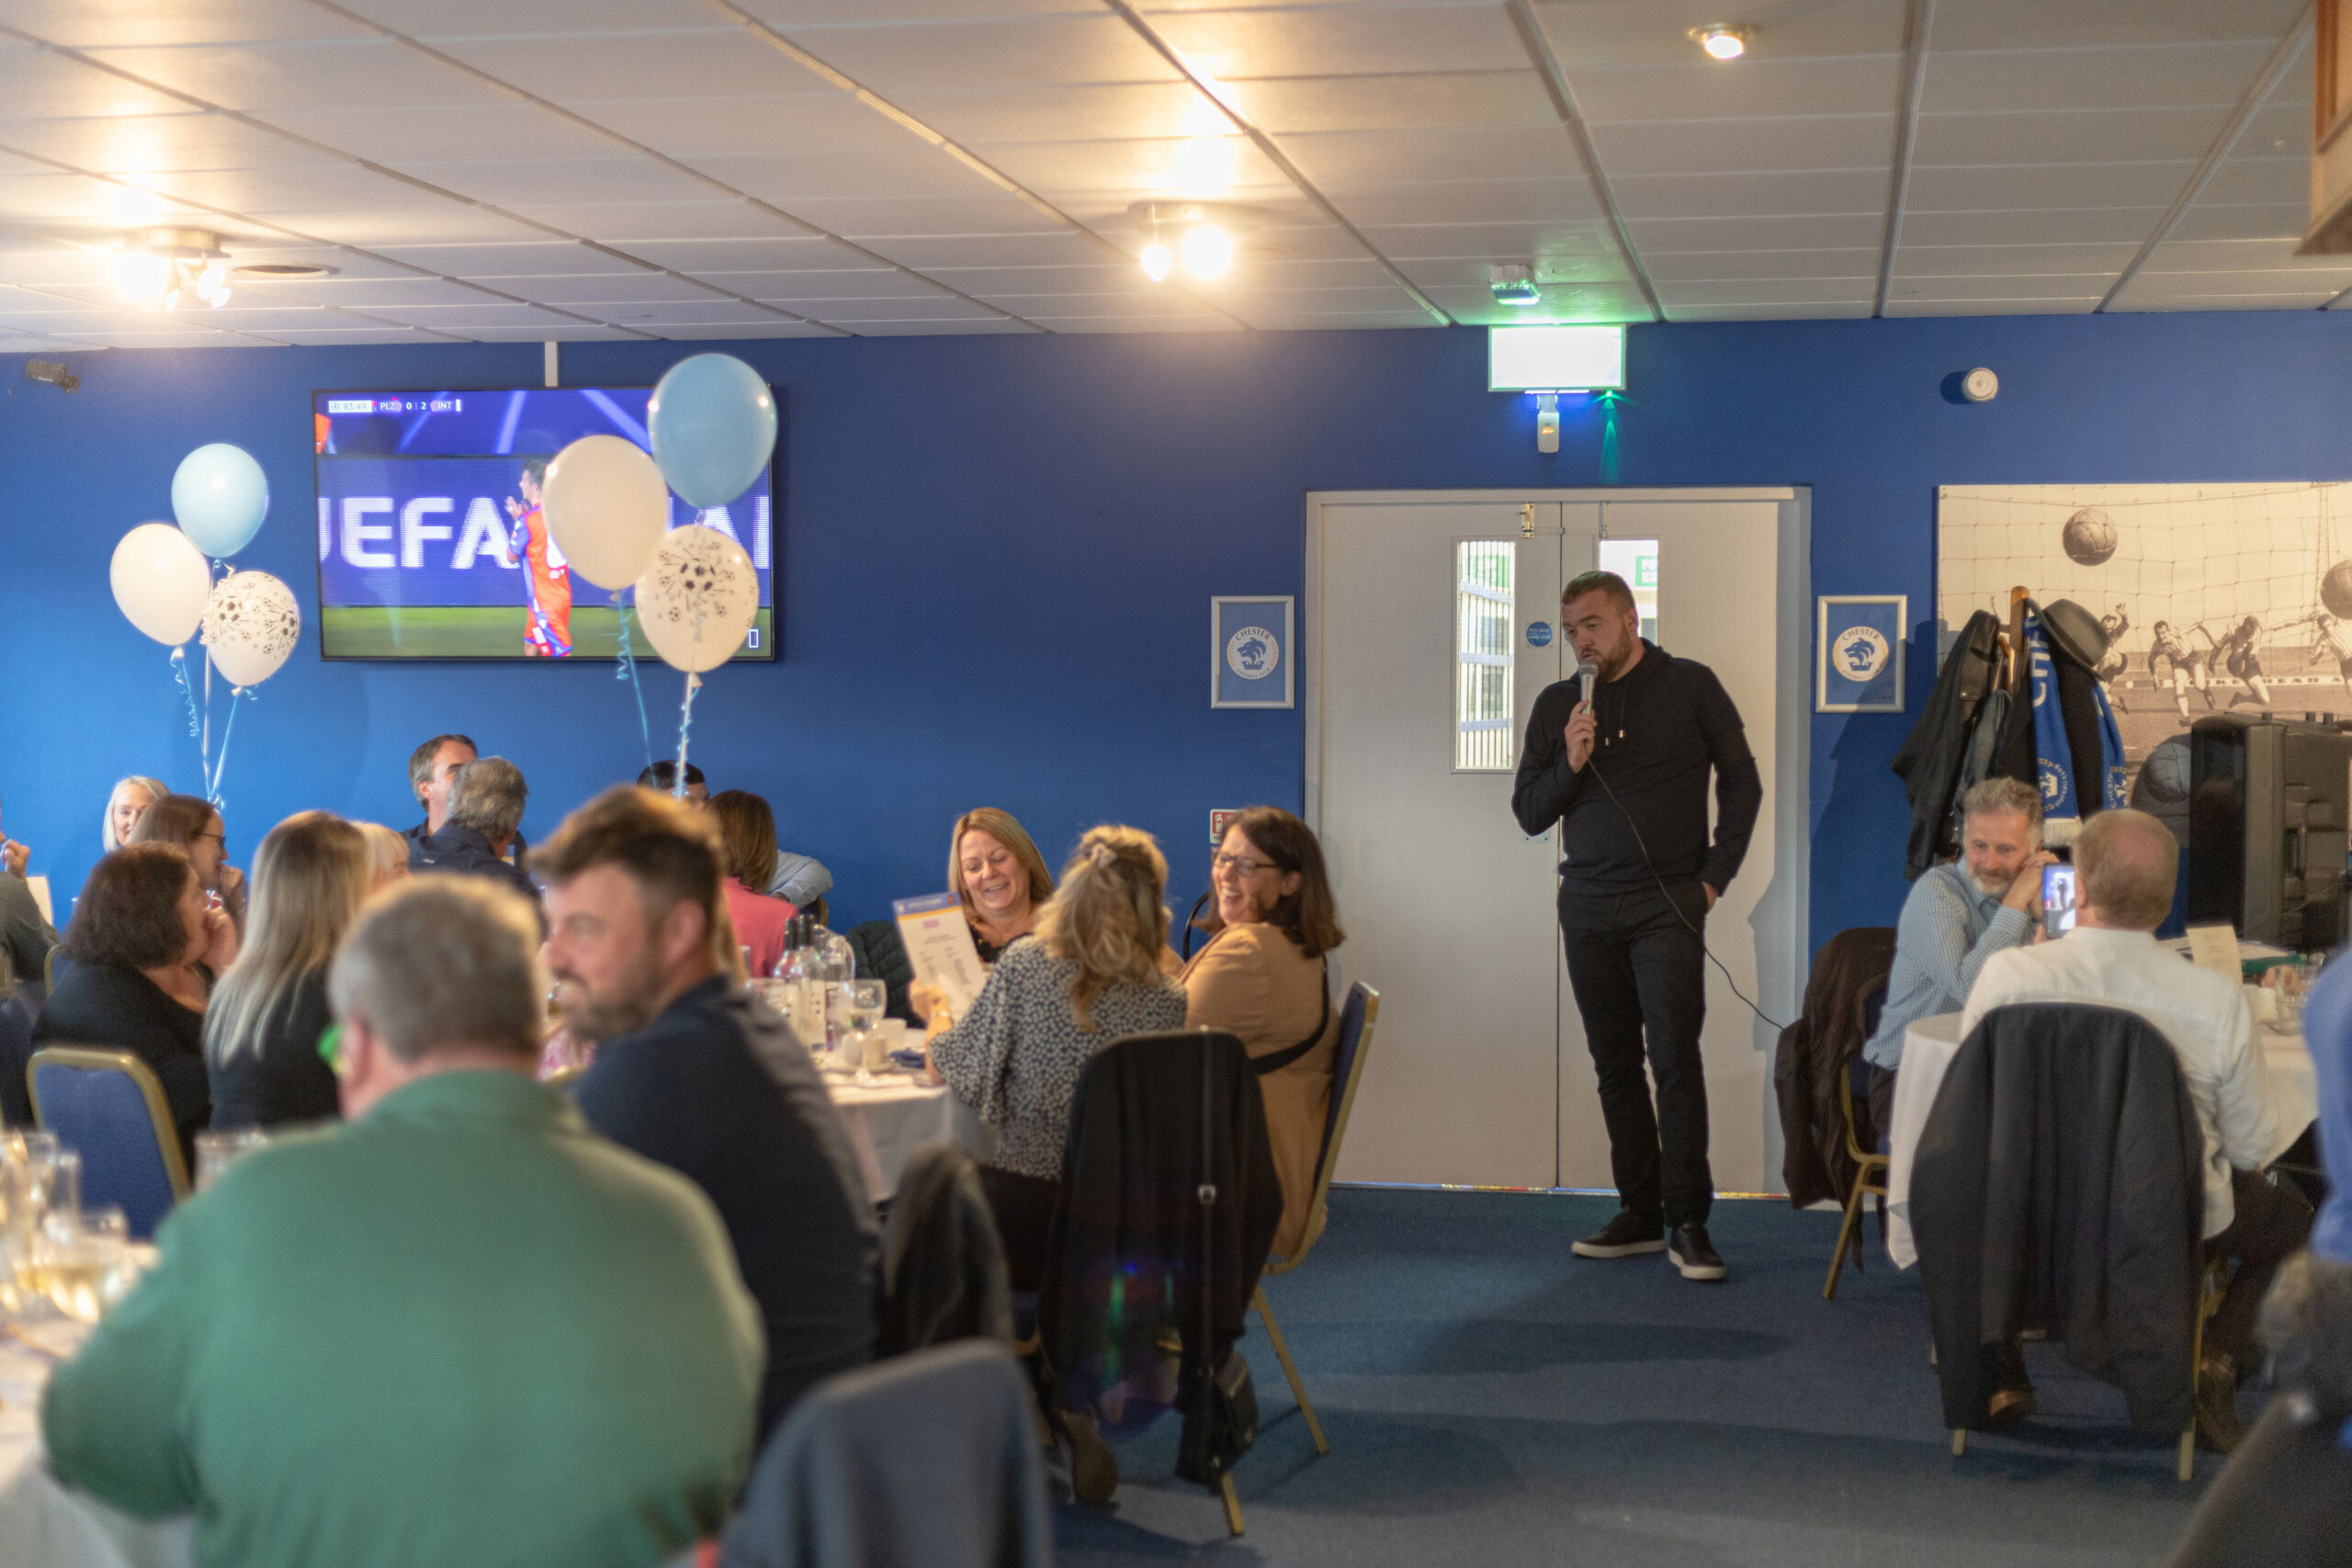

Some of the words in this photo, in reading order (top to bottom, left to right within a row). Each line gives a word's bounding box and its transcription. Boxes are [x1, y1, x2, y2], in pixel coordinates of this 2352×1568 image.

[379, 401, 395, 410] PLZ
[405, 401, 413, 410] 0
[420, 401, 426, 410] 2
[437, 401, 452, 410] INT
[318, 497, 520, 569] EFA
[1235, 628, 1271, 641] CHESTER
[1842, 628, 1880, 641] CHESTER
